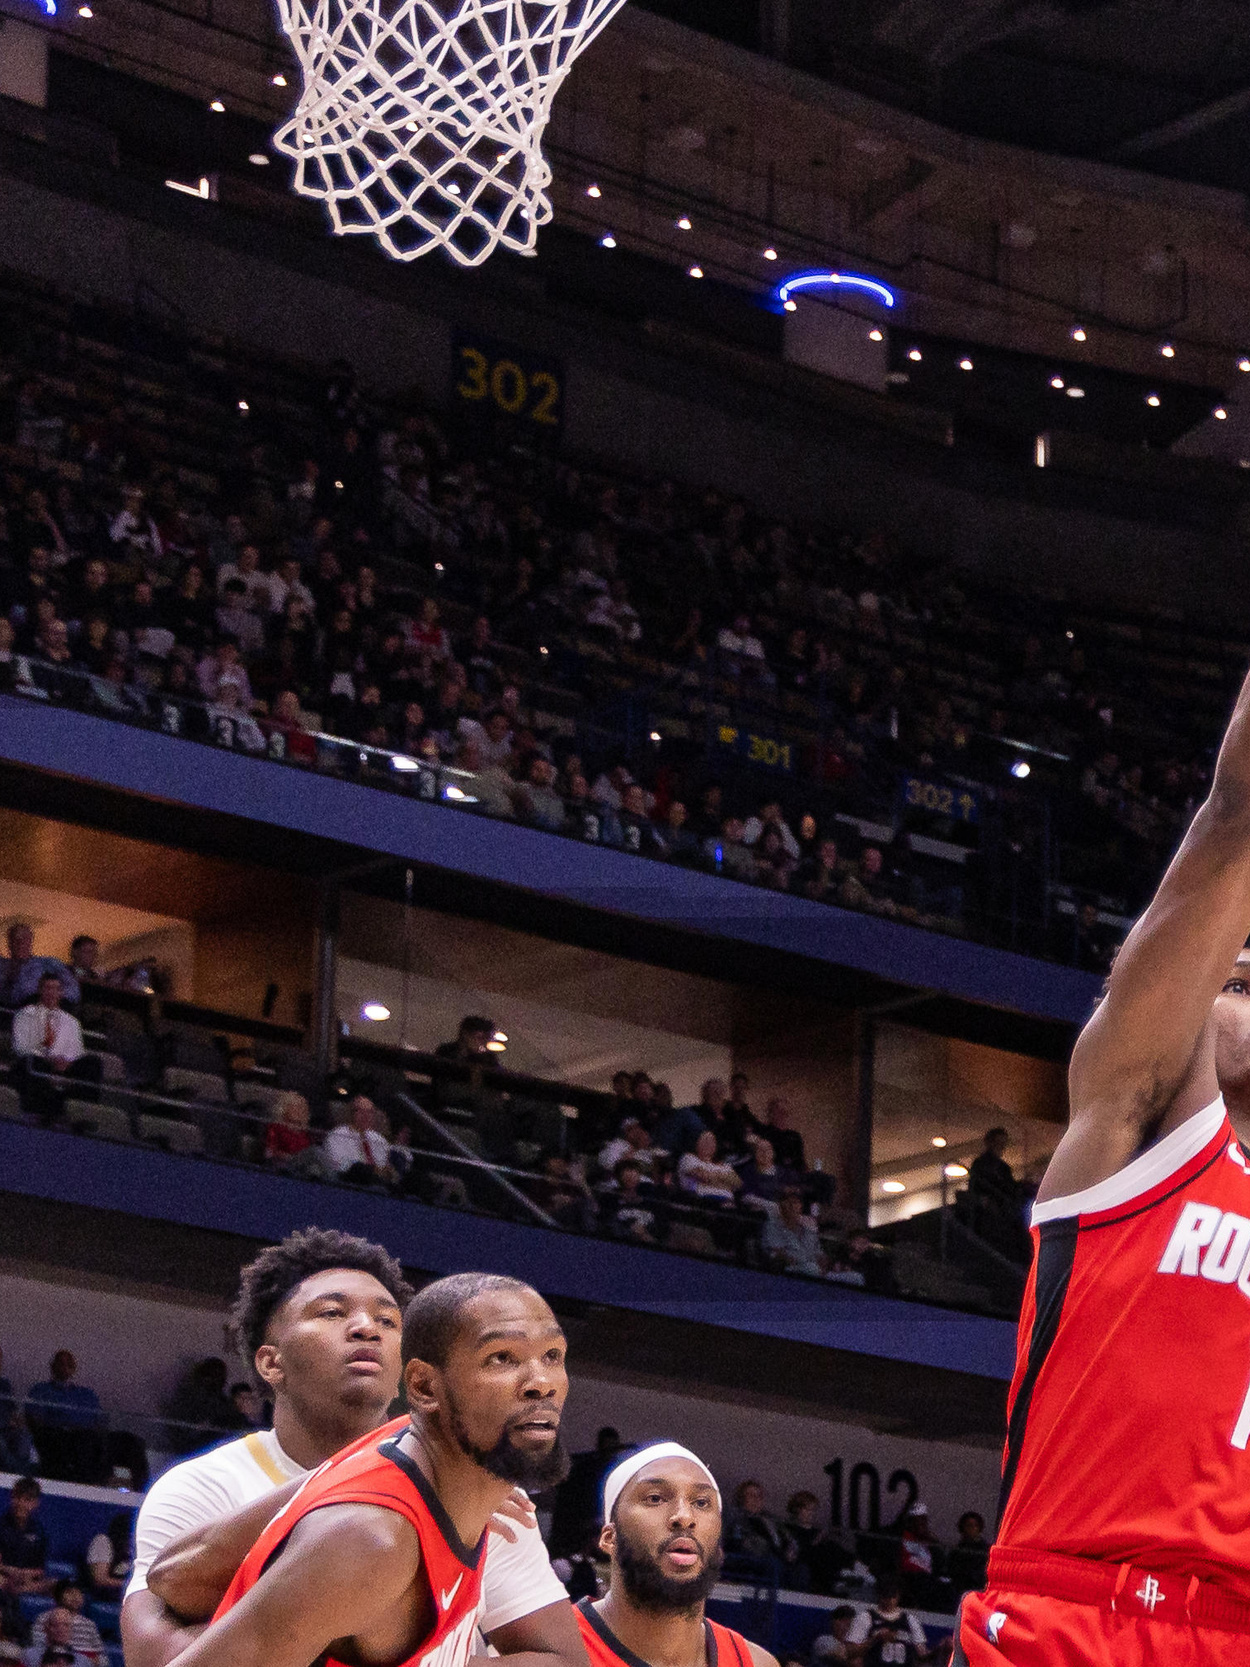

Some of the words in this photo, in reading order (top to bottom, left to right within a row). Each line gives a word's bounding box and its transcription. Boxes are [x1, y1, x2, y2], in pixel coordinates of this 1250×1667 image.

[457, 347, 559, 424] 302
[747, 733, 791, 771] 301
[905, 778, 954, 814] 302
[823, 1457, 919, 1534] 102
